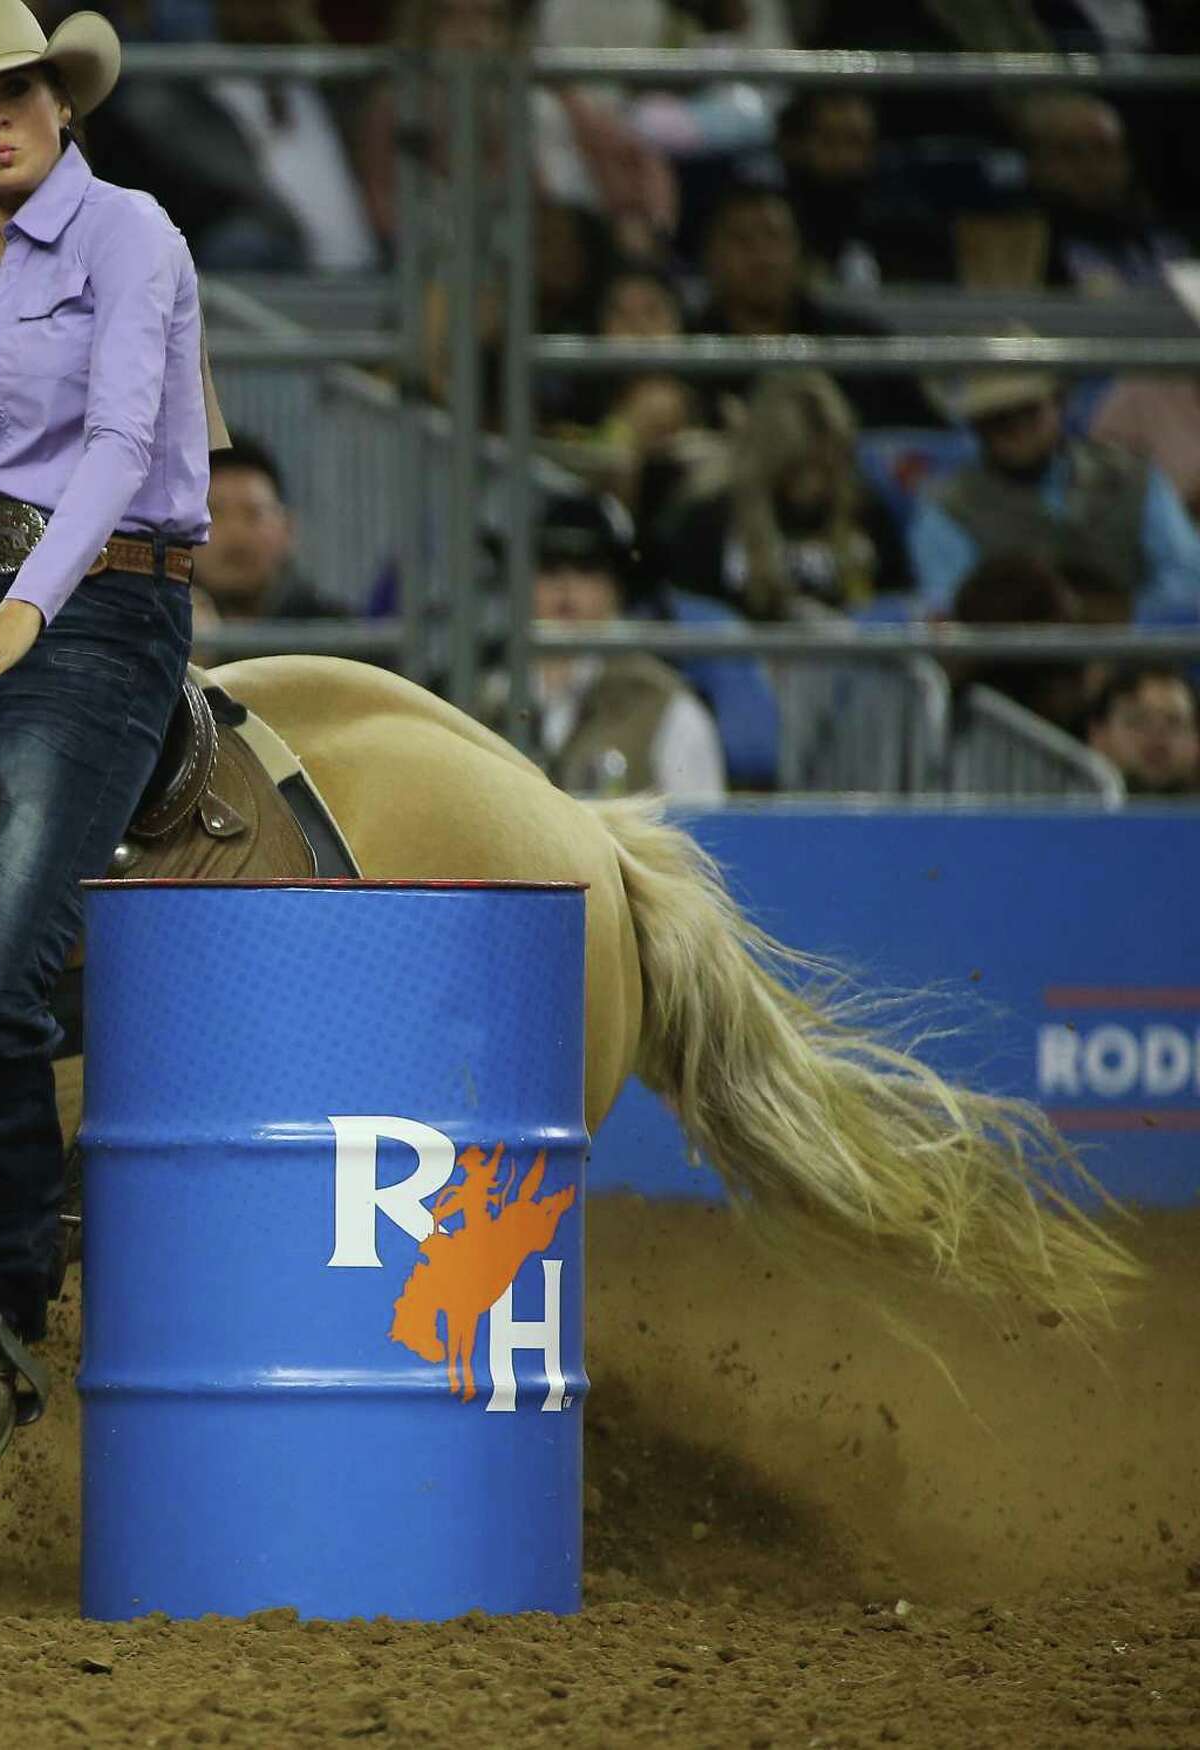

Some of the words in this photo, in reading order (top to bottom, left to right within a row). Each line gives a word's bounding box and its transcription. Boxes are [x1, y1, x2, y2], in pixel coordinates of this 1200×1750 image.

[1038, 1023, 1200, 1096] ROD
[327, 1116, 456, 1268] R
[485, 1259, 567, 1412] H
